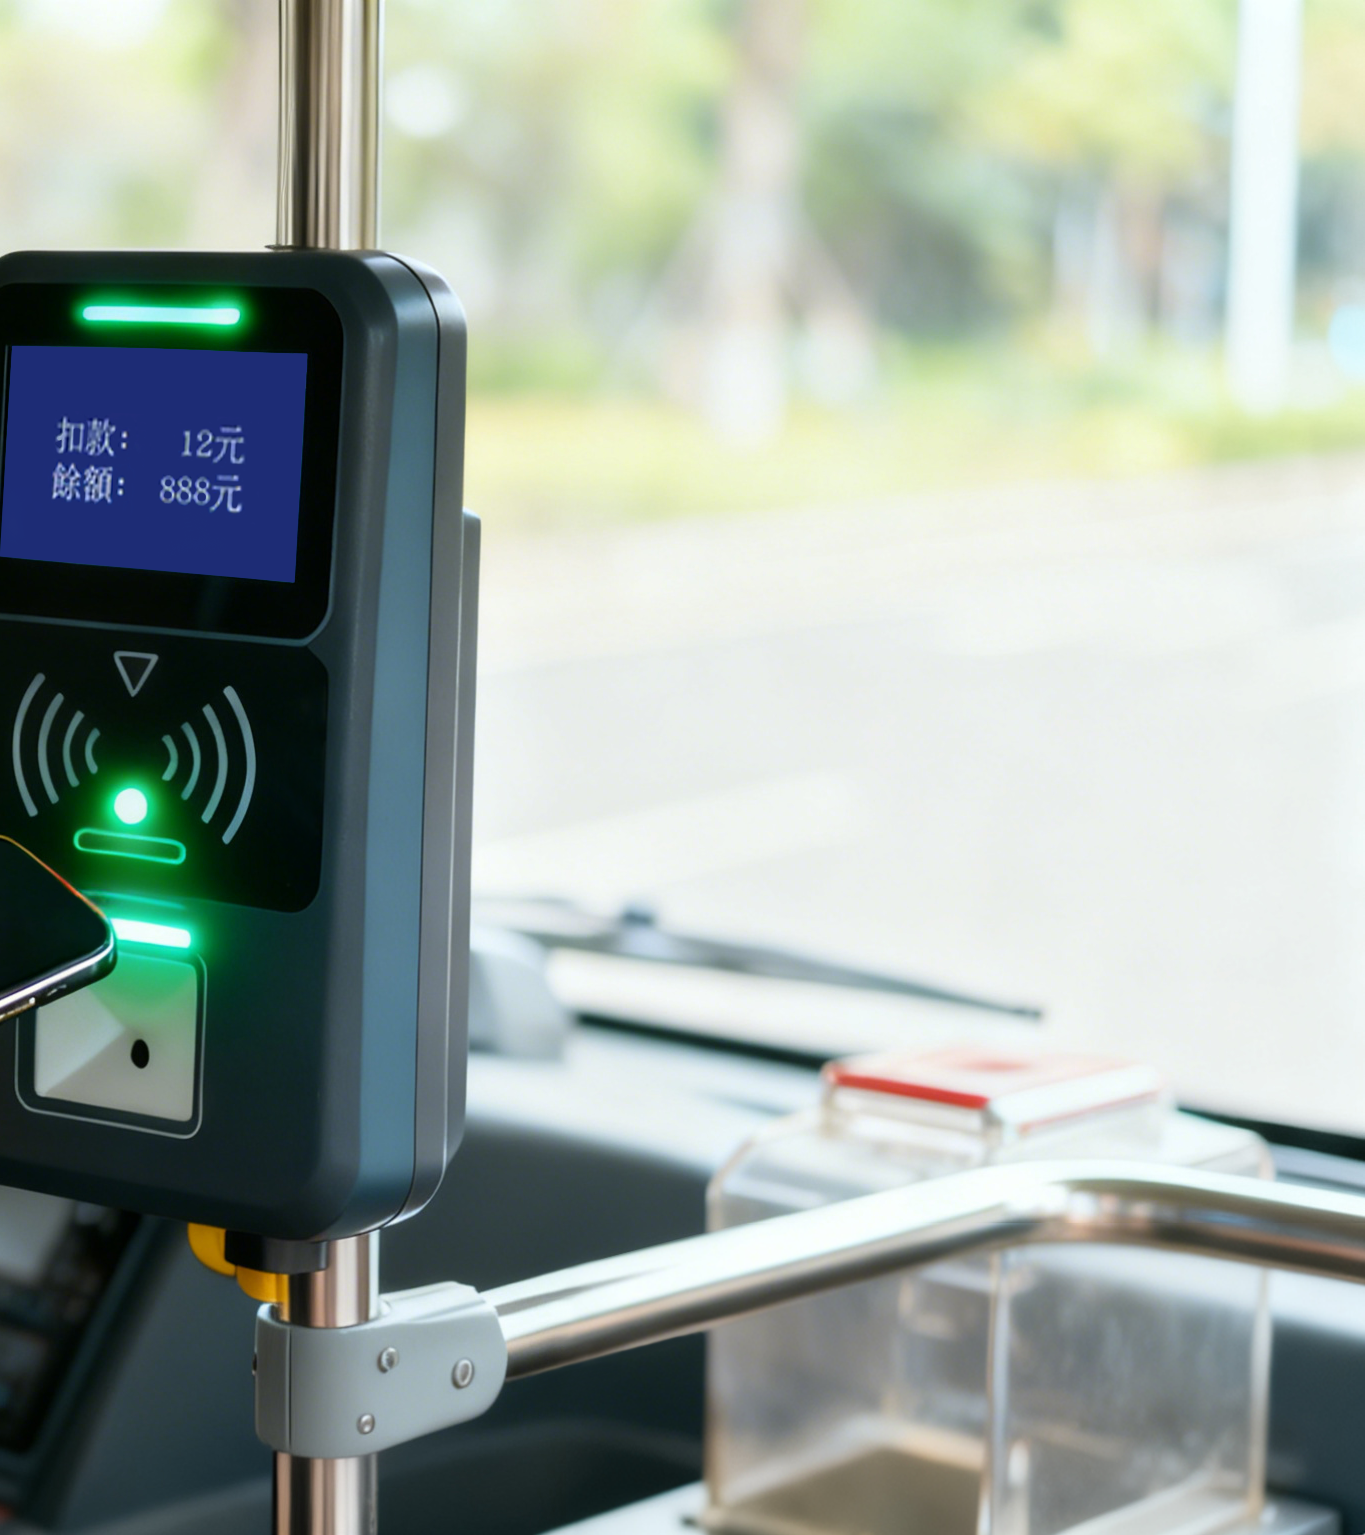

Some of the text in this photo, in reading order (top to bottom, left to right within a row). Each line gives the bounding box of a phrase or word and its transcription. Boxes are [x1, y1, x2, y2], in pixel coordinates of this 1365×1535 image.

[55, 416, 245, 465] 扣款： 12元
[51, 462, 243, 513] 餘額： 888元
